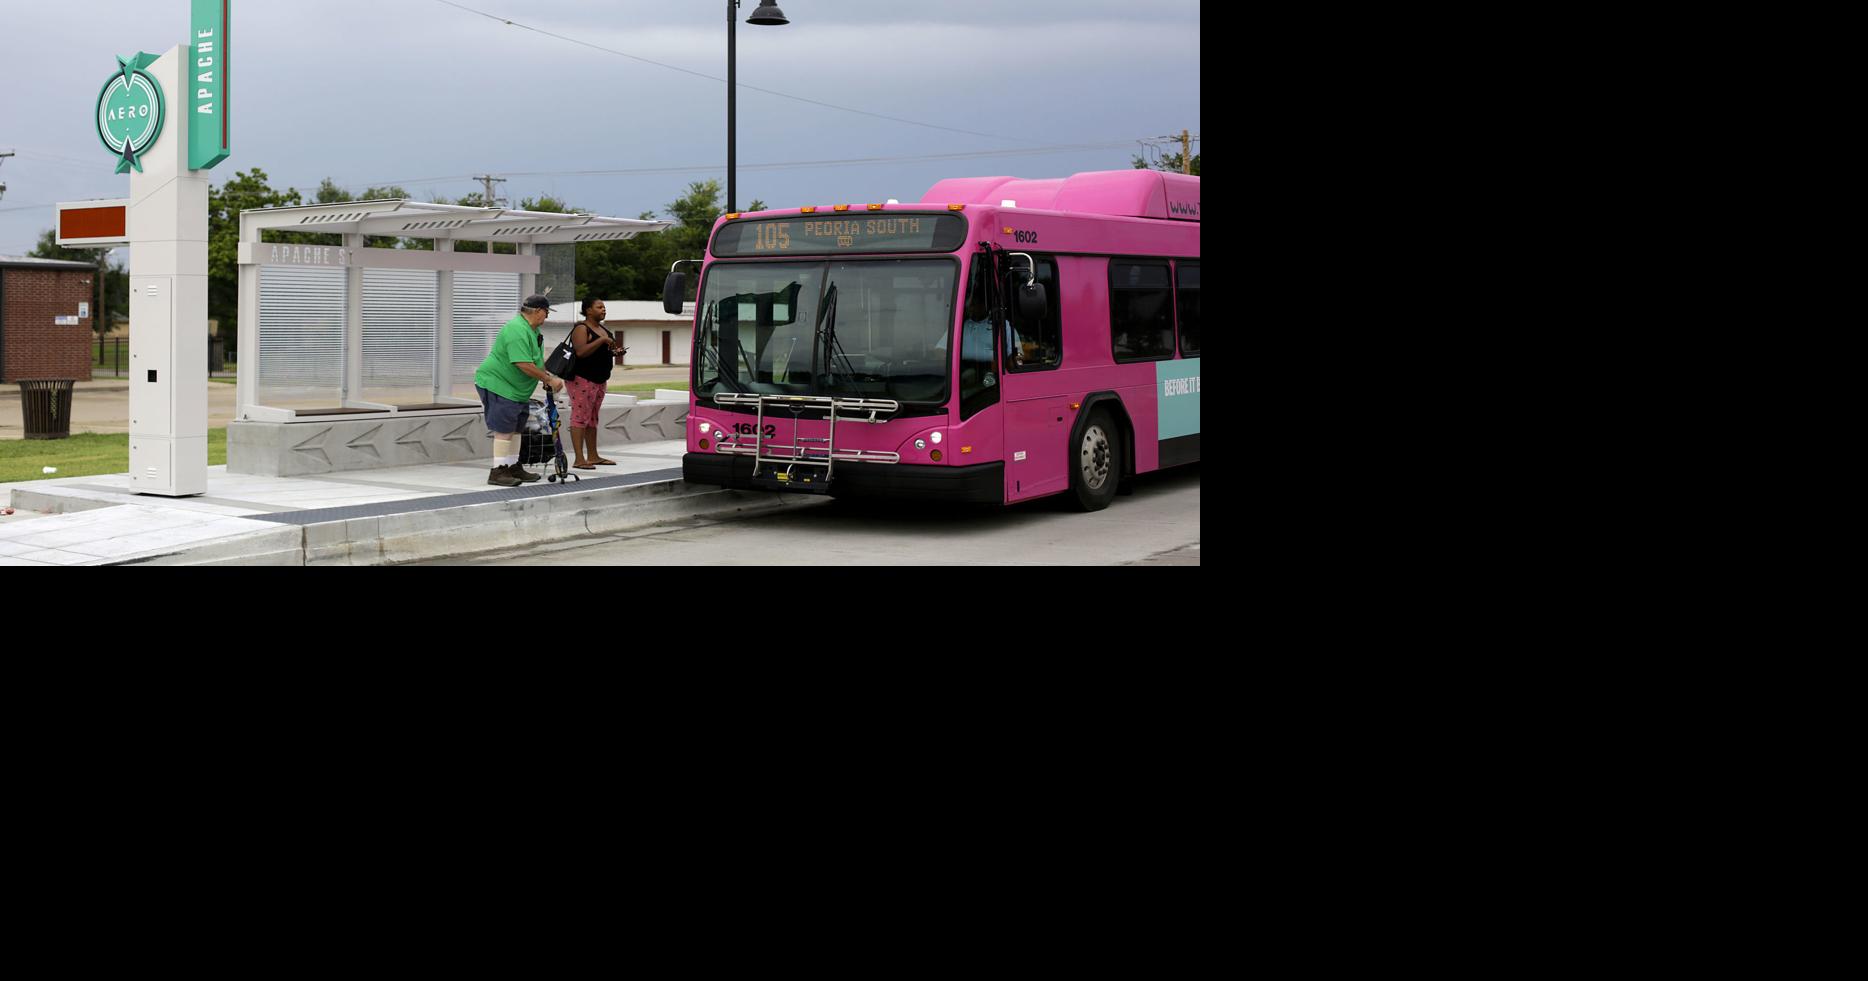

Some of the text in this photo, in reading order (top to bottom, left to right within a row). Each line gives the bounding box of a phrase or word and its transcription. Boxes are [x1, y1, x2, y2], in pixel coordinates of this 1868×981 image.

[197, 28, 213, 114] APACHE
[108, 104, 148, 121] AERO
[755, 222, 790, 249] 105
[804, 218, 920, 236] PEORIA SOUTH
[1014, 230, 1038, 244] 1602
[271, 245, 330, 264] APACHE
[1165, 378, 1189, 397] BEFORE
[1189, 377, 1196, 393] IT
[732, 422, 776, 439] 1602
